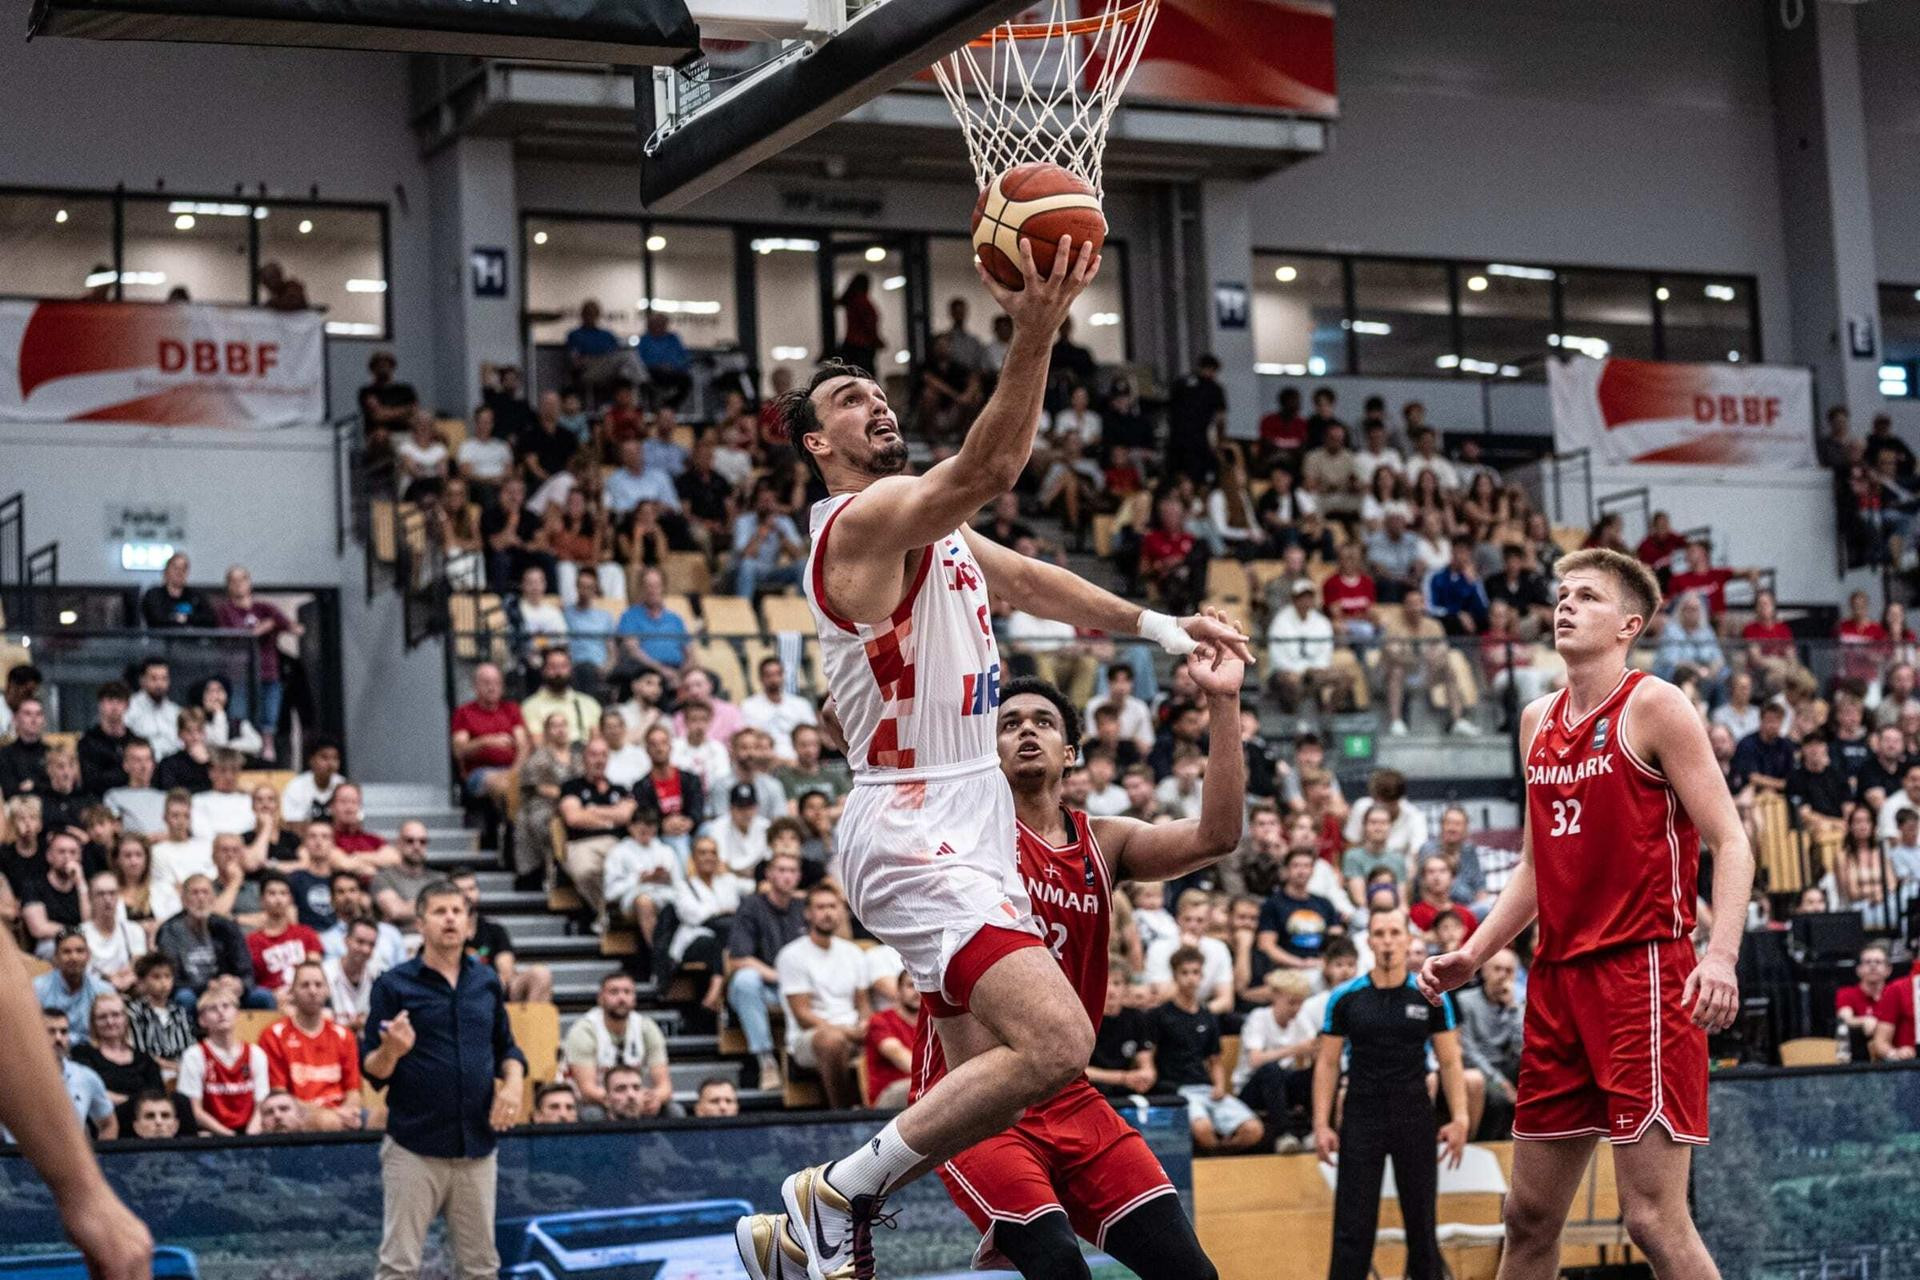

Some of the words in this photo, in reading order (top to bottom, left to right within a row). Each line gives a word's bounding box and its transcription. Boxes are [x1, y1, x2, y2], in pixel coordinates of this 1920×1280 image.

[158, 339, 279, 377] DBBF
[1694, 394, 1781, 425] DBBF
[1527, 753, 1613, 784] DANMARK
[1550, 798, 1581, 837] 32
